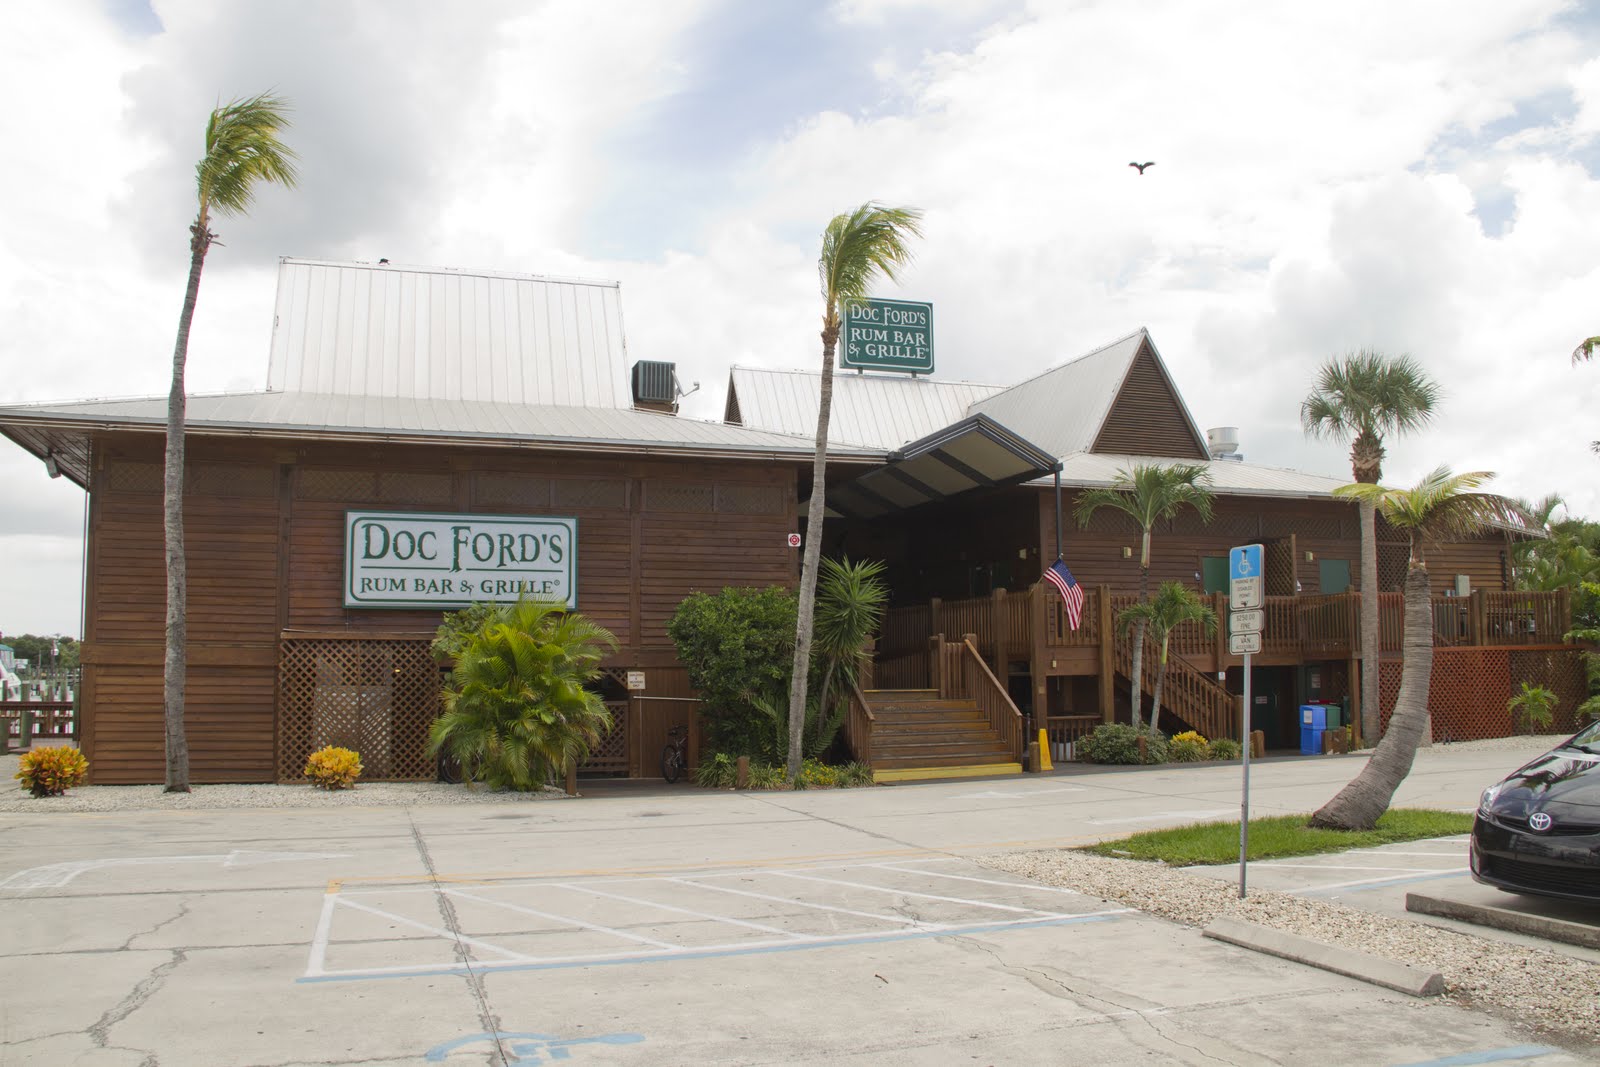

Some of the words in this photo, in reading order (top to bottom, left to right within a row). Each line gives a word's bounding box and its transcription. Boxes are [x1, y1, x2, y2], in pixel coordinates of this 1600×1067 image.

[883, 307, 926, 326] FORD'S
[851, 328, 888, 342] RUM
[893, 331, 927, 347] BAR
[848, 343, 860, 358] &
[449, 526, 563, 573] FORD'S
[360, 577, 407, 594] RUM
[414, 578, 453, 595] BAR
[460, 580, 474, 596] &
